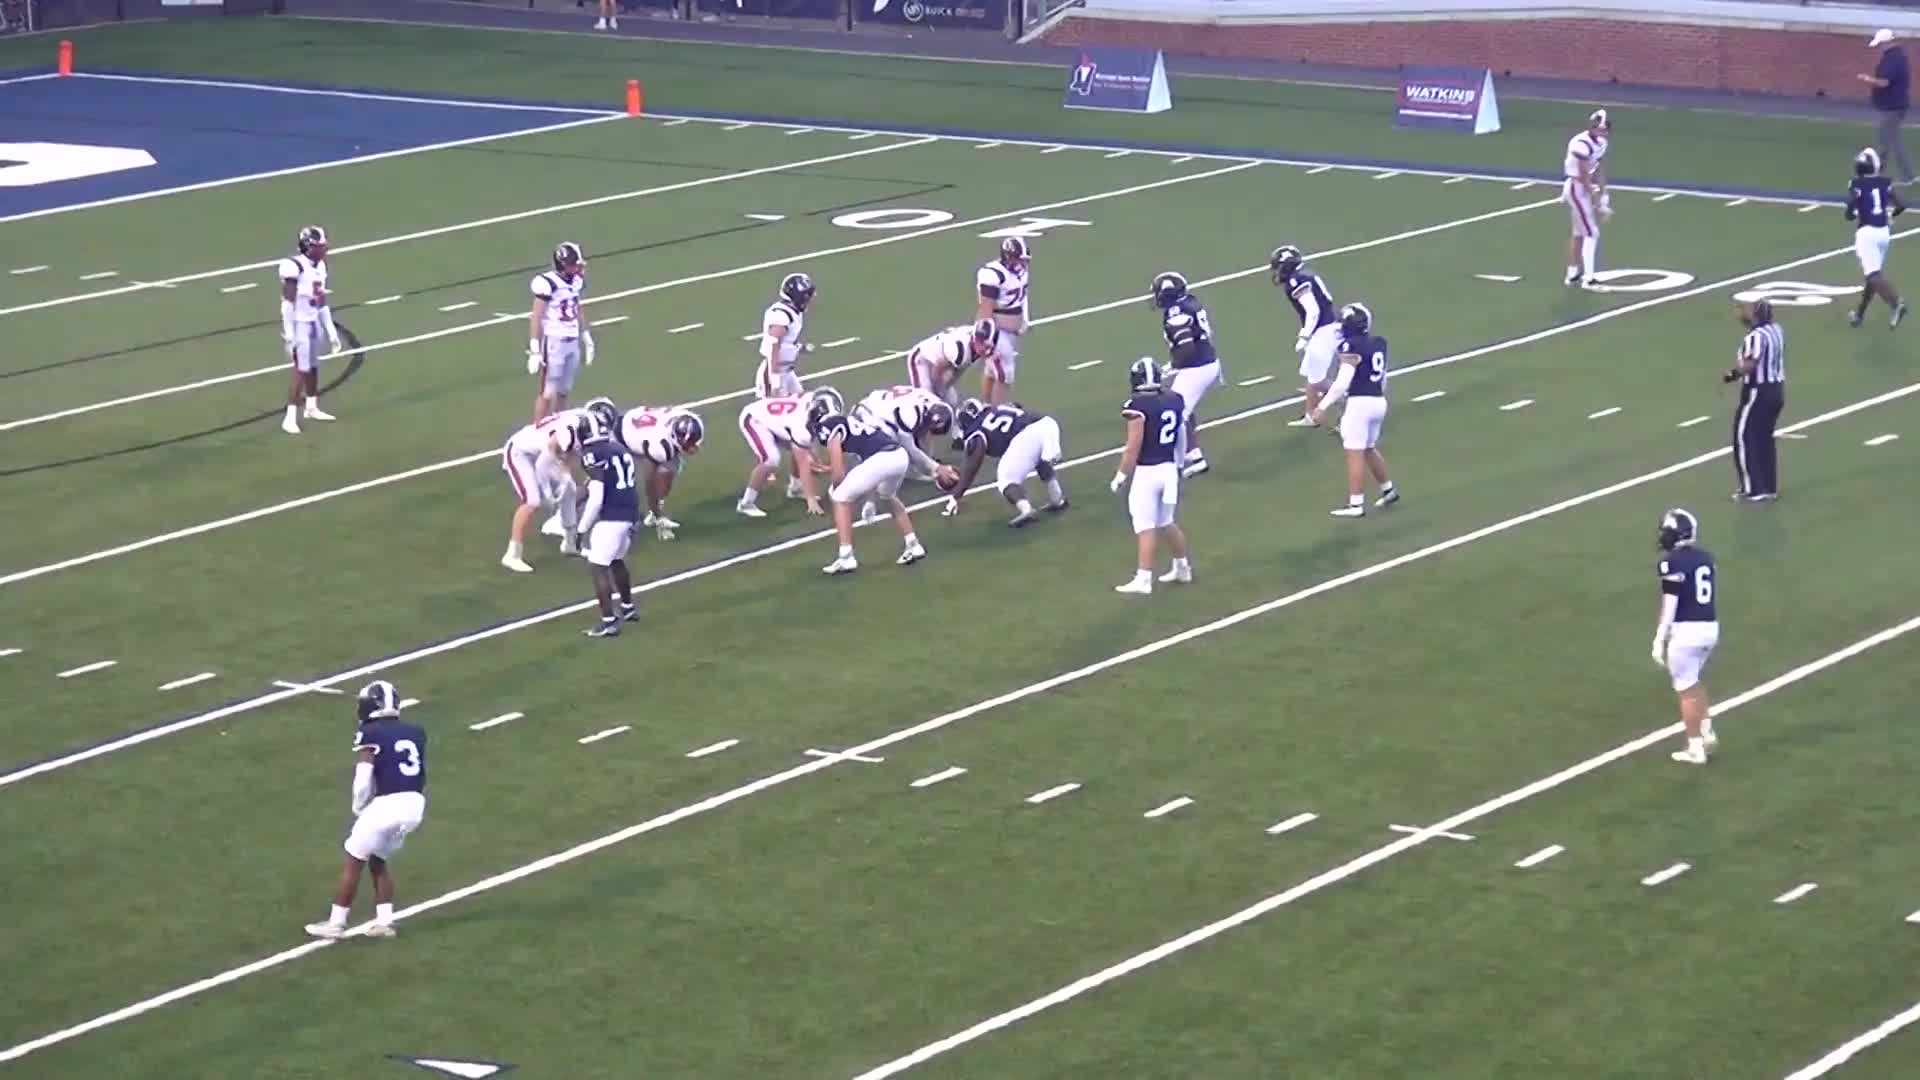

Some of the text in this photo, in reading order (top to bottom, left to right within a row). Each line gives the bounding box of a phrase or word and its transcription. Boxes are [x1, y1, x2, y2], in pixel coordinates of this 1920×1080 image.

[1406, 86, 1475, 103] WATKINS
[1871, 188, 1883, 215] 1
[1370, 351, 1384, 382] 9
[1160, 410, 1177, 444] 2
[1695, 565, 1712, 604] 6
[394, 739, 421, 777] 3
